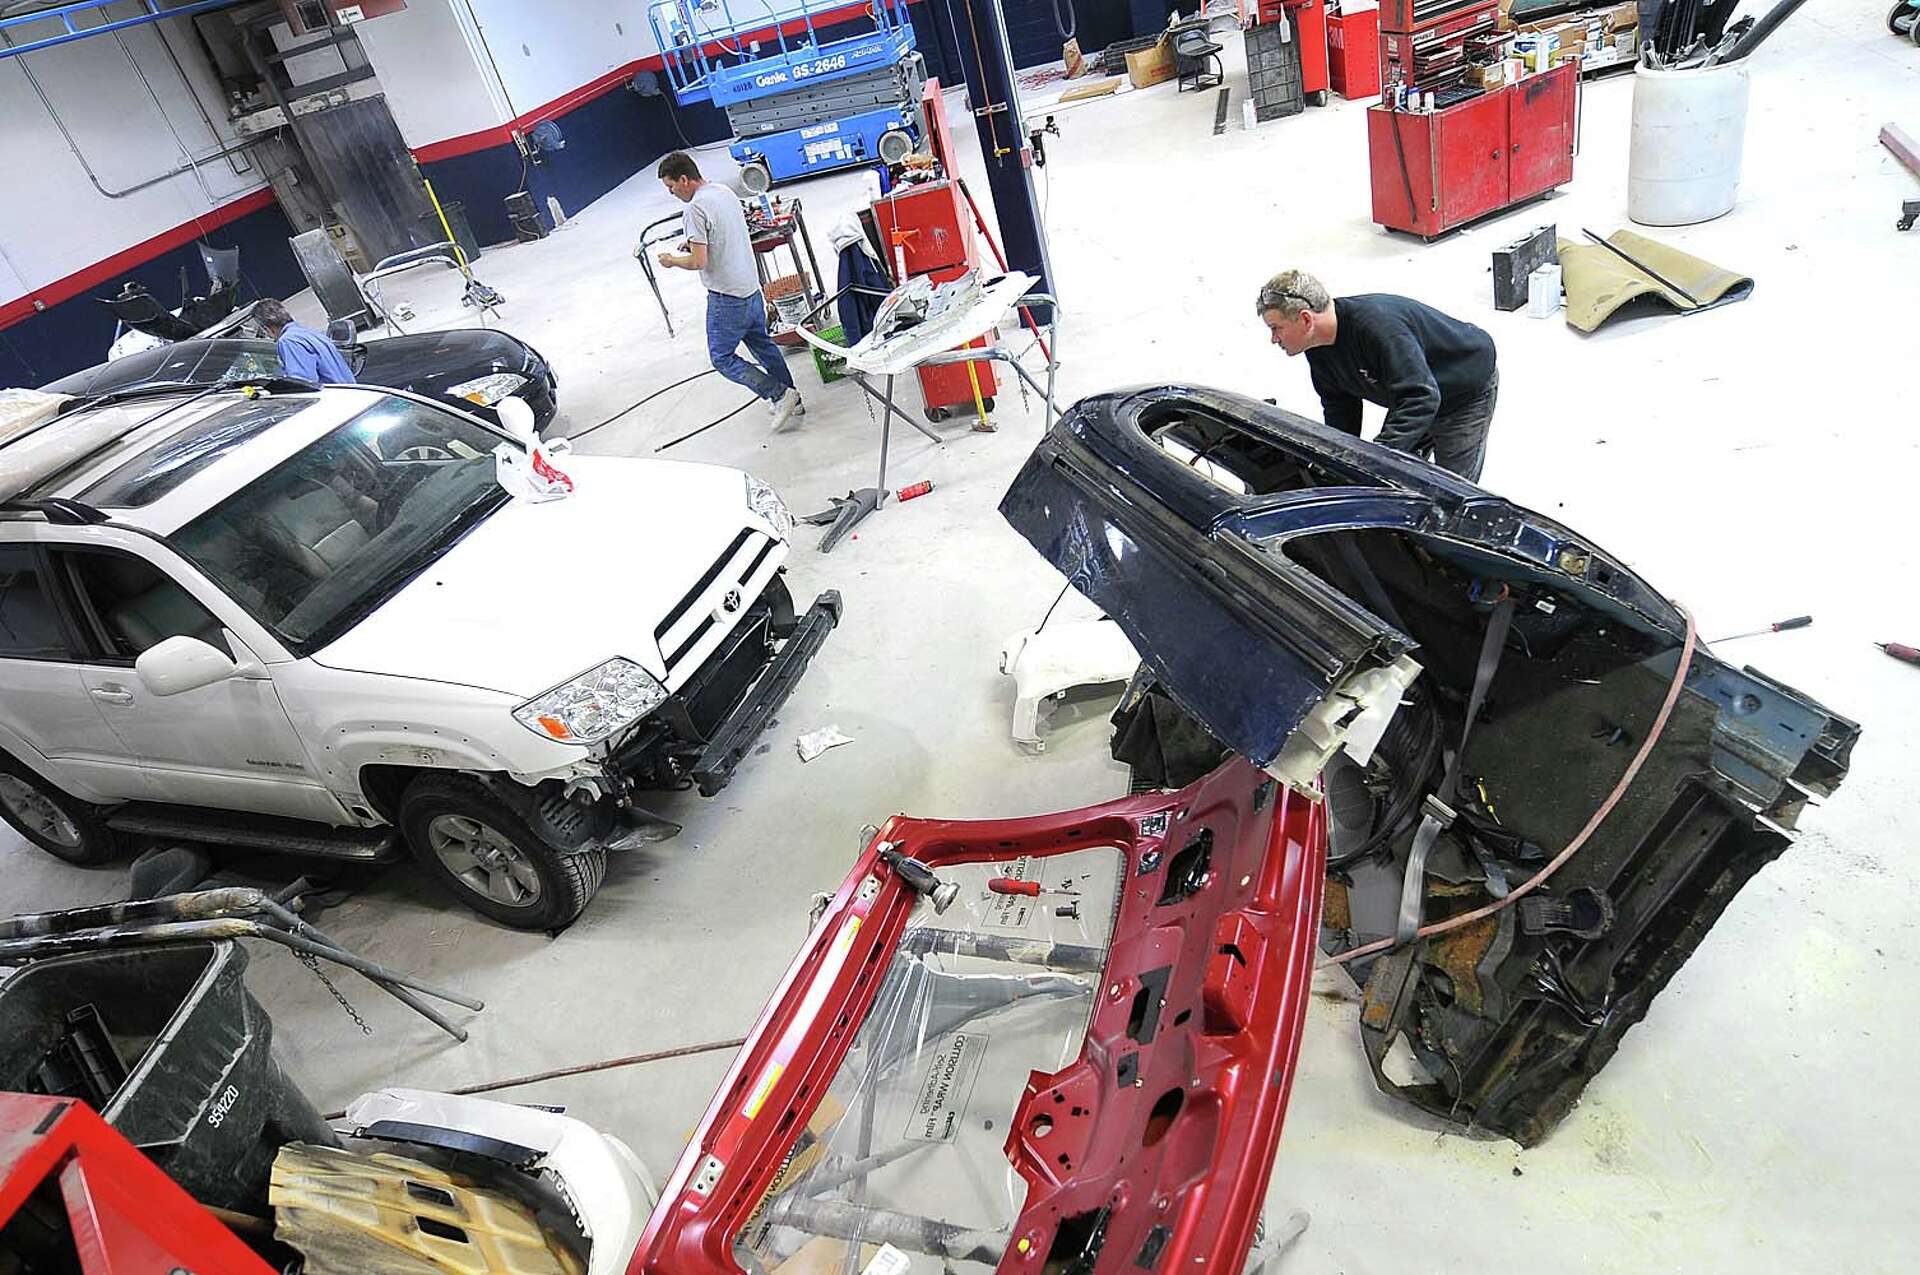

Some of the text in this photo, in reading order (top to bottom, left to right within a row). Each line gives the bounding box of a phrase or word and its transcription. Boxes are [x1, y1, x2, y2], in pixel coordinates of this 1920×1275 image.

[755, 55, 846, 88] Genie GS-2646
[208, 1084, 240, 1128] 954220
